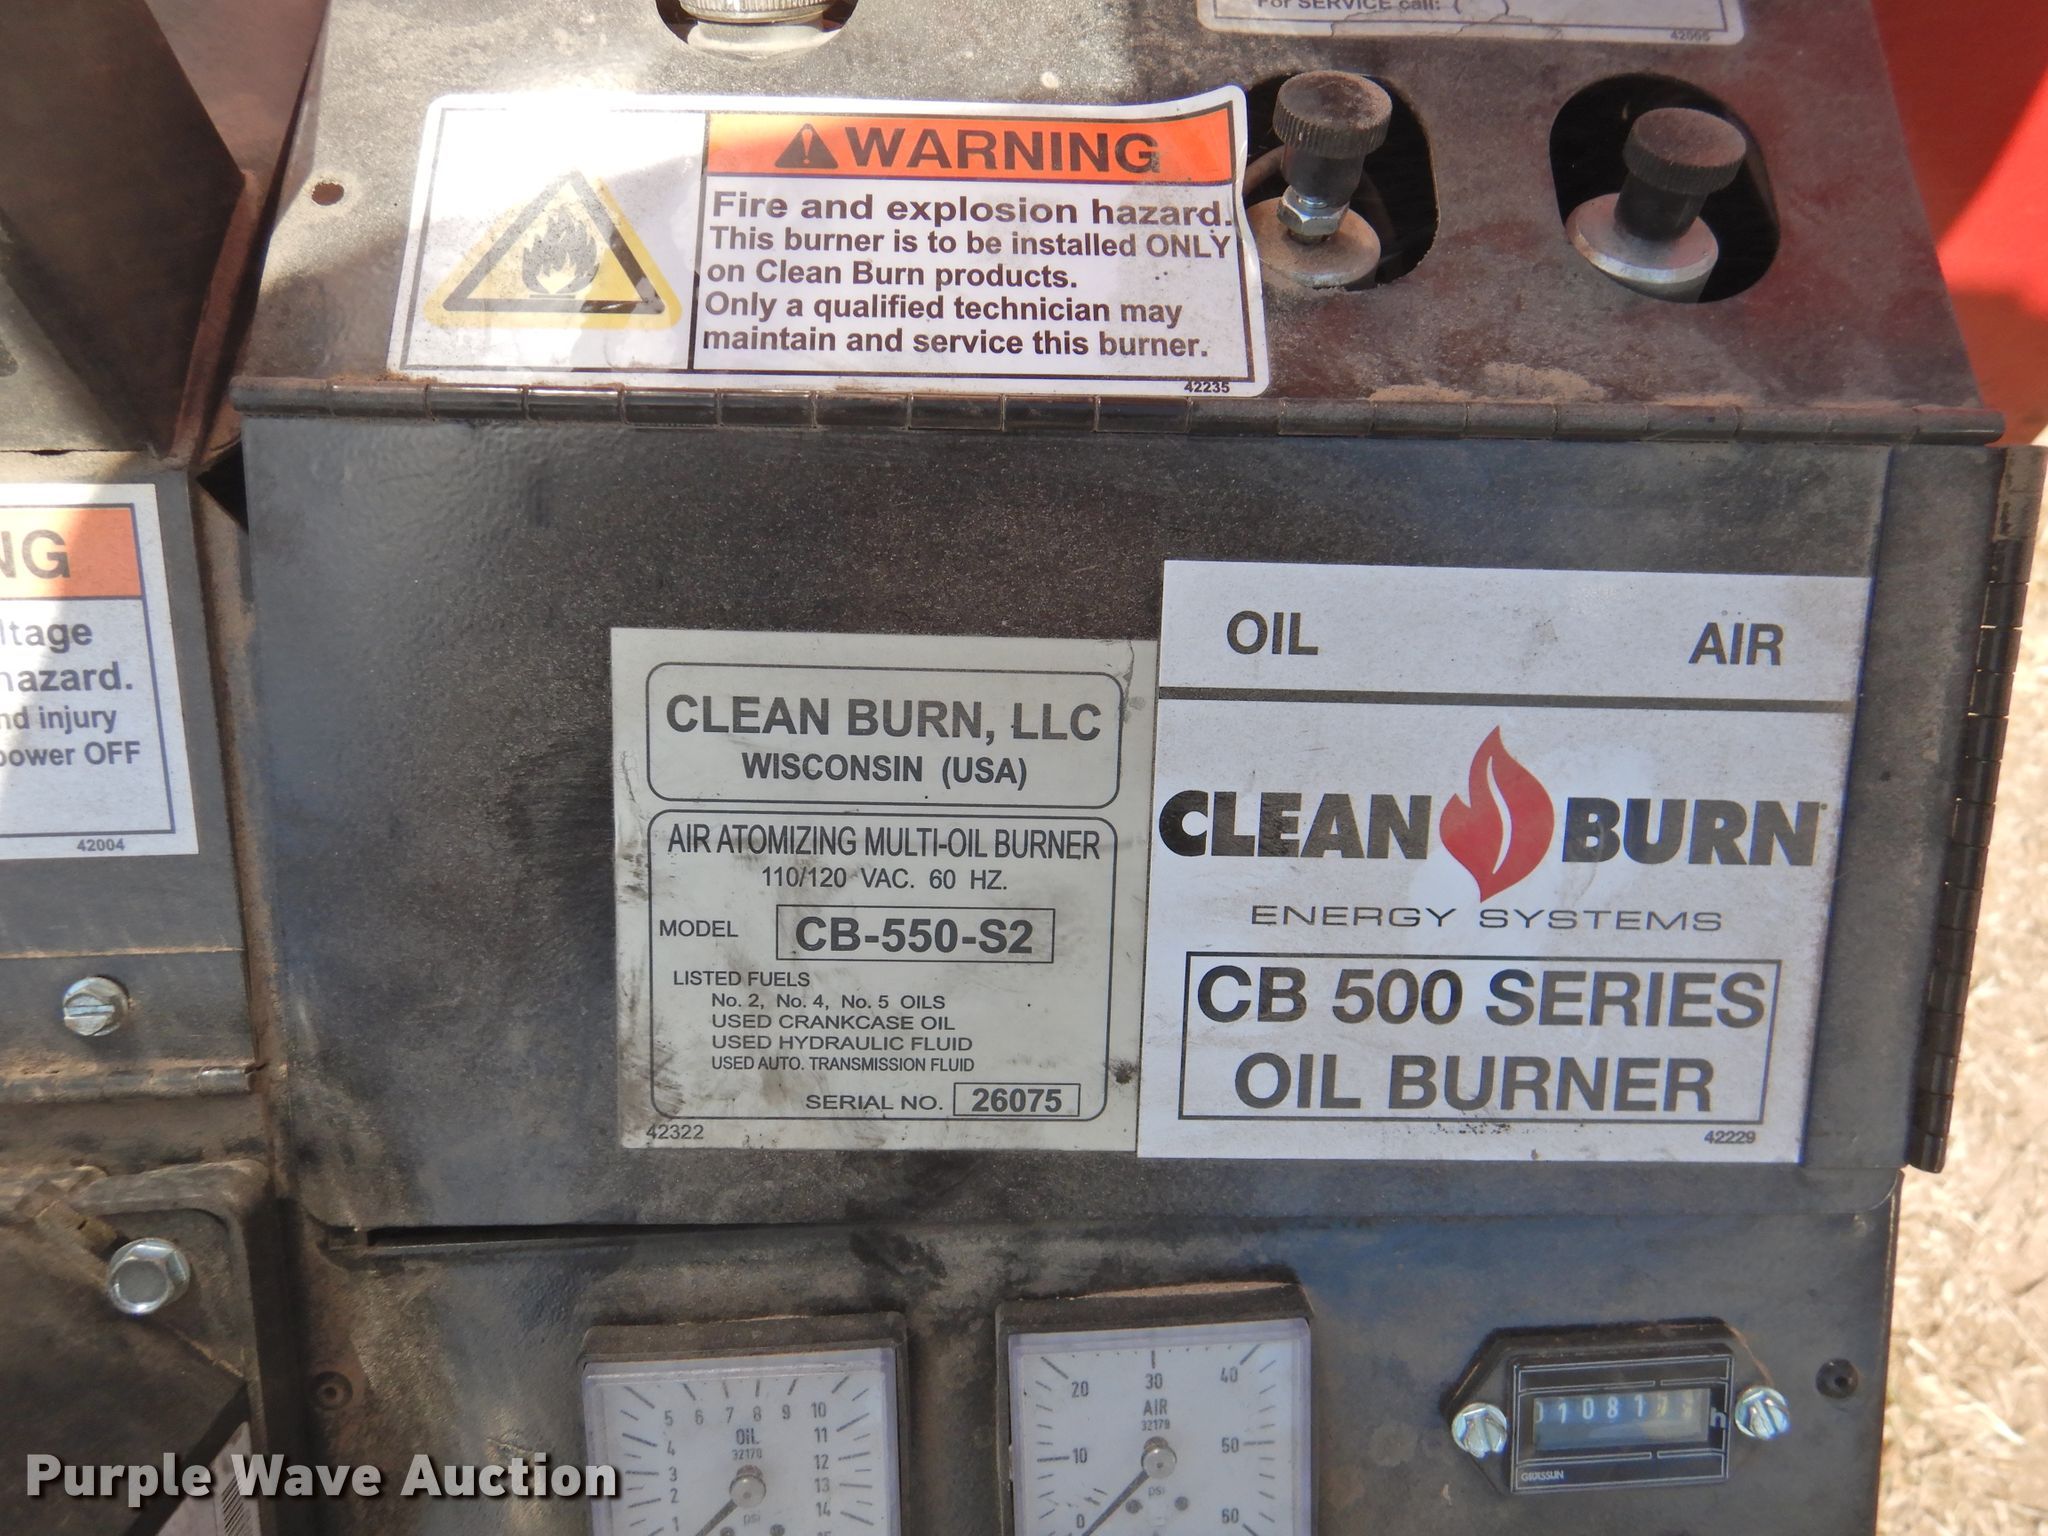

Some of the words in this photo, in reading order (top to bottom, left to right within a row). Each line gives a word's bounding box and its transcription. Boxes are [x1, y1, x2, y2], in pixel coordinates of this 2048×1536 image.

[846, 128, 1160, 174] WARNING
[714, 192, 788, 218] Fire
[801, 194, 872, 219] and
[887, 196, 1077, 226] explosion
[1092, 195, 1235, 231] hazard.
[710, 226, 773, 250] This
[785, 227, 884, 252] burner
[895, 229, 917, 252] is
[928, 231, 956, 253] to
[968, 231, 1001, 254] be
[1013, 232, 1136, 256] installed
[1146, 230, 1230, 258] ONLY
[708, 264, 744, 282] on
[756, 259, 841, 283] Clean
[853, 261, 924, 285] Burn
[936, 264, 1076, 291] products.
[705, 291, 777, 322] Only
[787, 299, 802, 316] a
[811, 294, 943, 322] qualified
[954, 296, 1109, 321] technician
[1121, 304, 1182, 329] may
[703, 326, 835, 351] maintain
[847, 328, 902, 352] and
[913, 329, 1023, 354] service
[1033, 330, 1088, 355] this
[1100, 331, 1207, 356] burner.
[1184, 381, 1229, 395] 42235
[1227, 611, 1318, 655] OIL
[1689, 623, 1783, 665] AIR
[39, 705, 116, 734] injury
[667, 695, 829, 735] CLEAN
[848, 699, 994, 746] BURN,
[1011, 703, 1101, 741] LLC
[84, 741, 140, 765] OFF
[742, 753, 922, 782] WISCONSIN
[943, 756, 1026, 791] (USA)
[1159, 790, 1431, 859] CLEAN
[1562, 797, 1821, 866] BURN
[76, 838, 125, 852] 42004
[668, 824, 711, 853] AIR
[717, 825, 856, 855] ATOMIZING
[865, 827, 987, 857] MULTI-OIL
[995, 829, 1099, 860] BURNER
[763, 866, 846, 888] 110/120
[861, 868, 914, 888] VAC.
[930, 869, 955, 889] 60
[971, 870, 1007, 890] HZ.
[1252, 905, 1456, 927] ENERGY
[1480, 909, 1721, 931] SYSTEMS
[660, 920, 738, 937] MODEL
[795, 917, 1033, 954] CB-550-S2
[674, 971, 741, 985] LISTED
[748, 972, 810, 987] FUELS
[712, 993, 741, 1007] No.
[749, 994, 764, 1009] 2,
[777, 994, 806, 1008] No.
[813, 994, 828, 1010] 4,
[842, 995, 871, 1008] No.
[879, 995, 888, 1008] 5
[901, 995, 945, 1009] OILS
[1198, 965, 1306, 1023] CB
[1332, 969, 1462, 1025] 500
[1486, 969, 1765, 1028] SERIES
[713, 1014, 771, 1028] USED
[779, 1015, 914, 1030] CRANKCASE
[921, 1016, 955, 1030] OIL
[713, 1035, 771, 1049] USED
[780, 1036, 904, 1050] HYDRAULIC
[912, 1037, 972, 1051] FLUID
[712, 1056, 754, 1070] USED
[758, 1056, 804, 1070] AUTO.
[809, 1057, 925, 1071] TRANSMISSION
[931, 1058, 974, 1071] FLUID
[1235, 1053, 1361, 1109] OIL
[1389, 1055, 1713, 1112] BURNER
[806, 1095, 893, 1109] SERIAL
[901, 1096, 942, 1110] NO.
[972, 1088, 1061, 1112] 26075
[646, 1124, 704, 1141] 42322
[1704, 1131, 1756, 1144] 42229
[1145, 1373, 1163, 1390] 30
[1220, 1366, 1238, 1384] 40
[1071, 1381, 1089, 1398] 20
[725, 1407, 735, 1424] 7
[752, 1406, 762, 1422] 8
[781, 1404, 791, 1421] 9
[811, 1400, 827, 1418] 10
[1143, 1399, 1168, 1416] AIR
[663, 1410, 674, 1426] 5
[694, 1409, 705, 1424] 6
[813, 1426, 829, 1443] 11
[666, 1441, 676, 1455] 4
[1221, 1437, 1239, 1454] 50
[814, 1454, 829, 1470] 12
[1073, 1447, 1088, 1464] 10
[668, 1466, 678, 1482] 3
[814, 1478, 831, 1494] 13
[670, 1488, 679, 1503] 2
[816, 1500, 832, 1517] 14
[1221, 1508, 1239, 1524] 60
[671, 1516, 680, 1531] 1
[1076, 1514, 1085, 1529] 0
